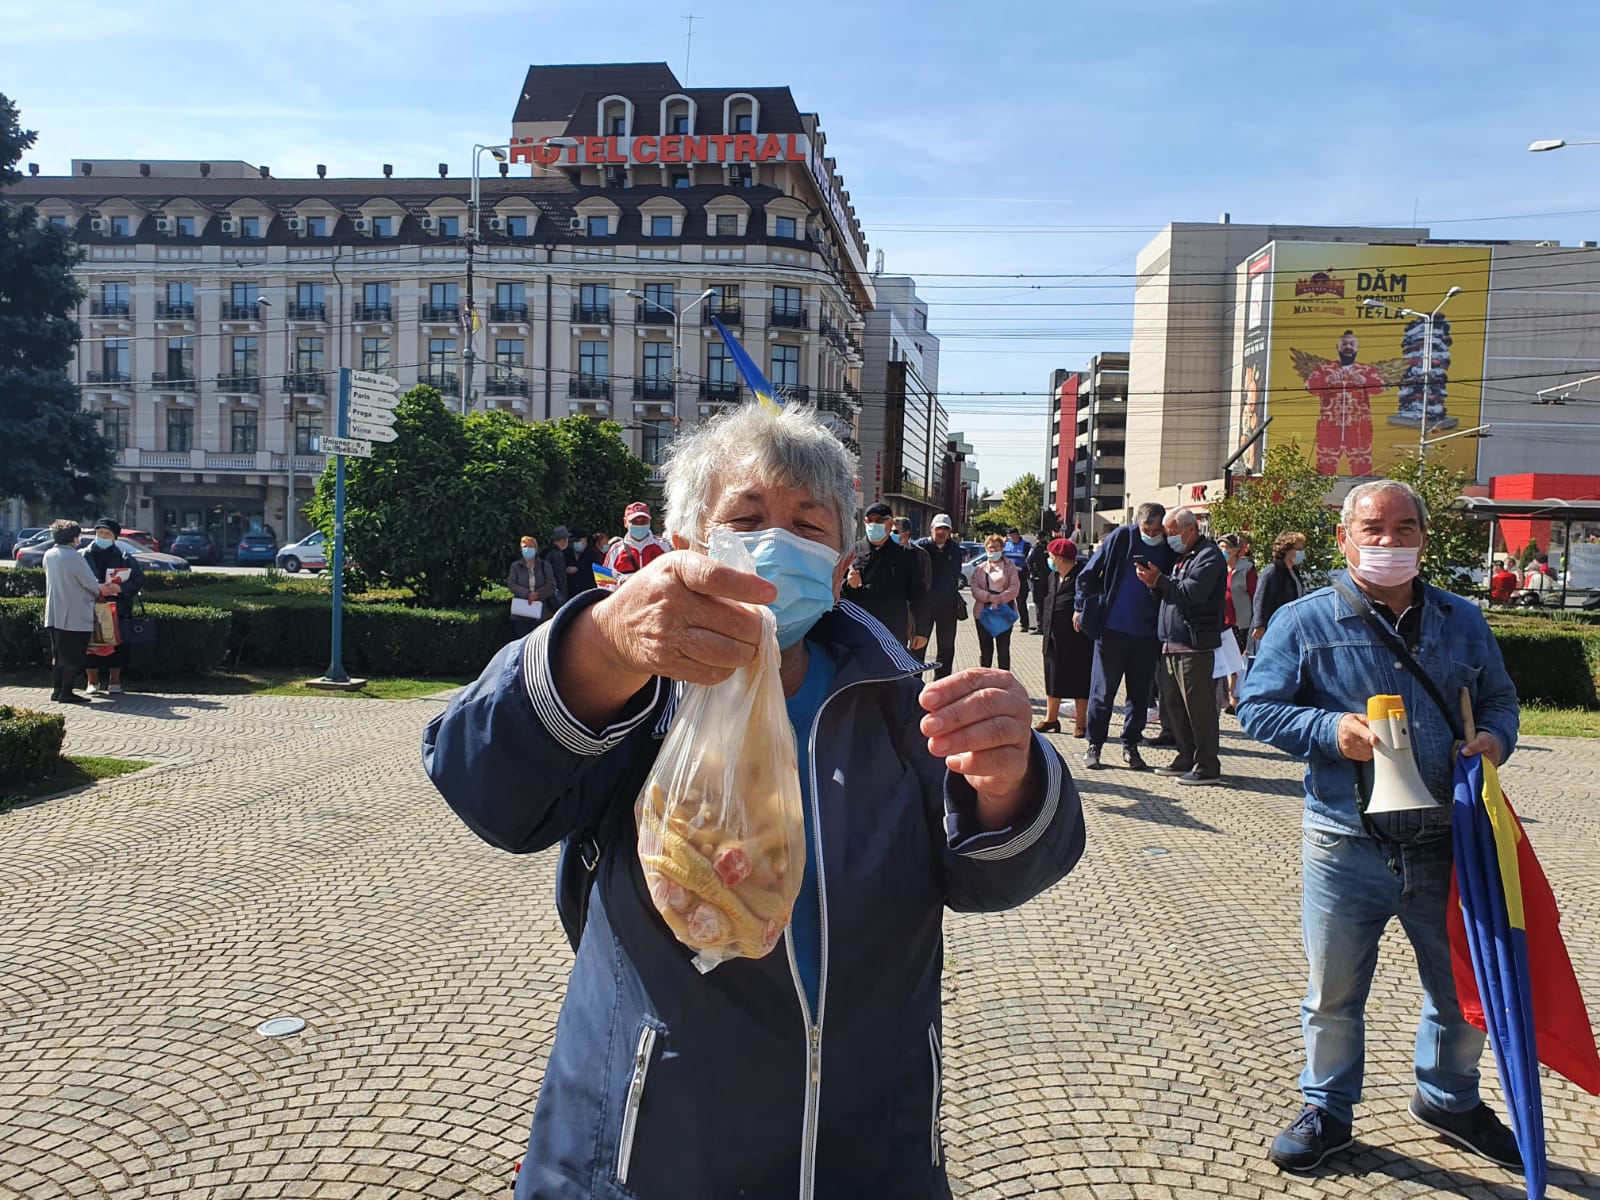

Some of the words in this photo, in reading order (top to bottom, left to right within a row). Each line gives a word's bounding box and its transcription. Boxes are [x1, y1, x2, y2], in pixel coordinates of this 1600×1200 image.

[510, 136, 627, 164] HOTEL
[632, 134, 806, 162] CENTRAL
[1356, 267, 1408, 292] DĂM
[354, 374, 377, 385] Londra
[353, 391, 370, 400] Paris
